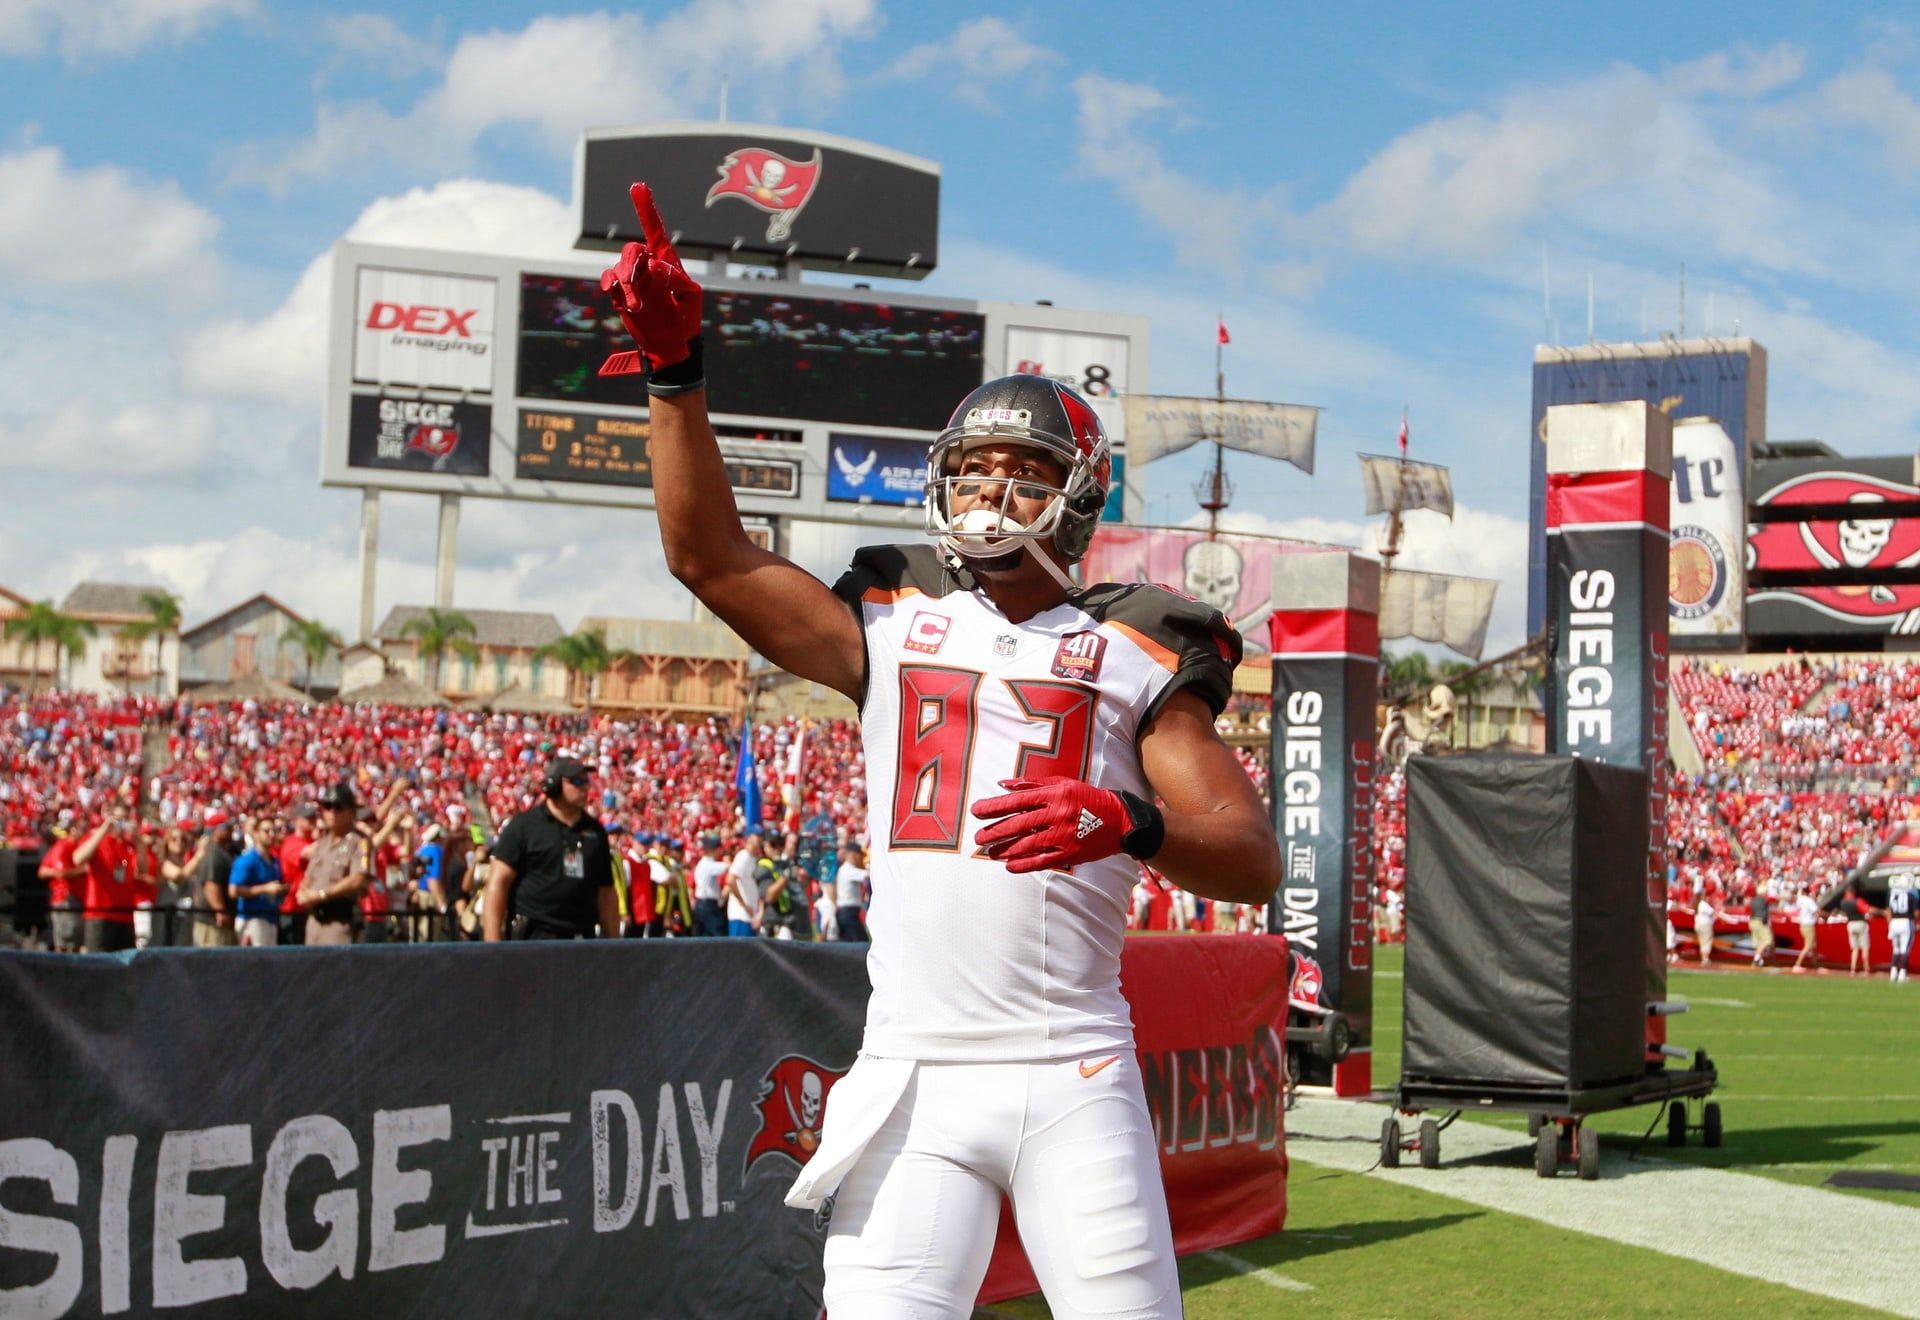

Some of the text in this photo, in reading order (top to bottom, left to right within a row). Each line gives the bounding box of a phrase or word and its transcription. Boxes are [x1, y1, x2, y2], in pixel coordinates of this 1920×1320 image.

[366, 301, 477, 337] DEX
[391, 334, 487, 355] imaging
[1083, 363, 1111, 397] 8
[380, 400, 454, 426] SIEGE
[542, 430, 557, 451] 0
[880, 466, 912, 478] AIR
[909, 613, 946, 645] C
[995, 642, 1012, 654] NFL
[1065, 634, 1099, 659] 40
[1567, 570, 1615, 745] SIEGE
[1284, 691, 1322, 836] SIEGE
[1077, 818, 1103, 838] adidas
[1292, 845, 1313, 882] THE
[1283, 888, 1319, 950] DAY
[0, 1103, 452, 1320] SIEGE
[481, 1131, 562, 1211] THE
[591, 1079, 733, 1233] DAY
